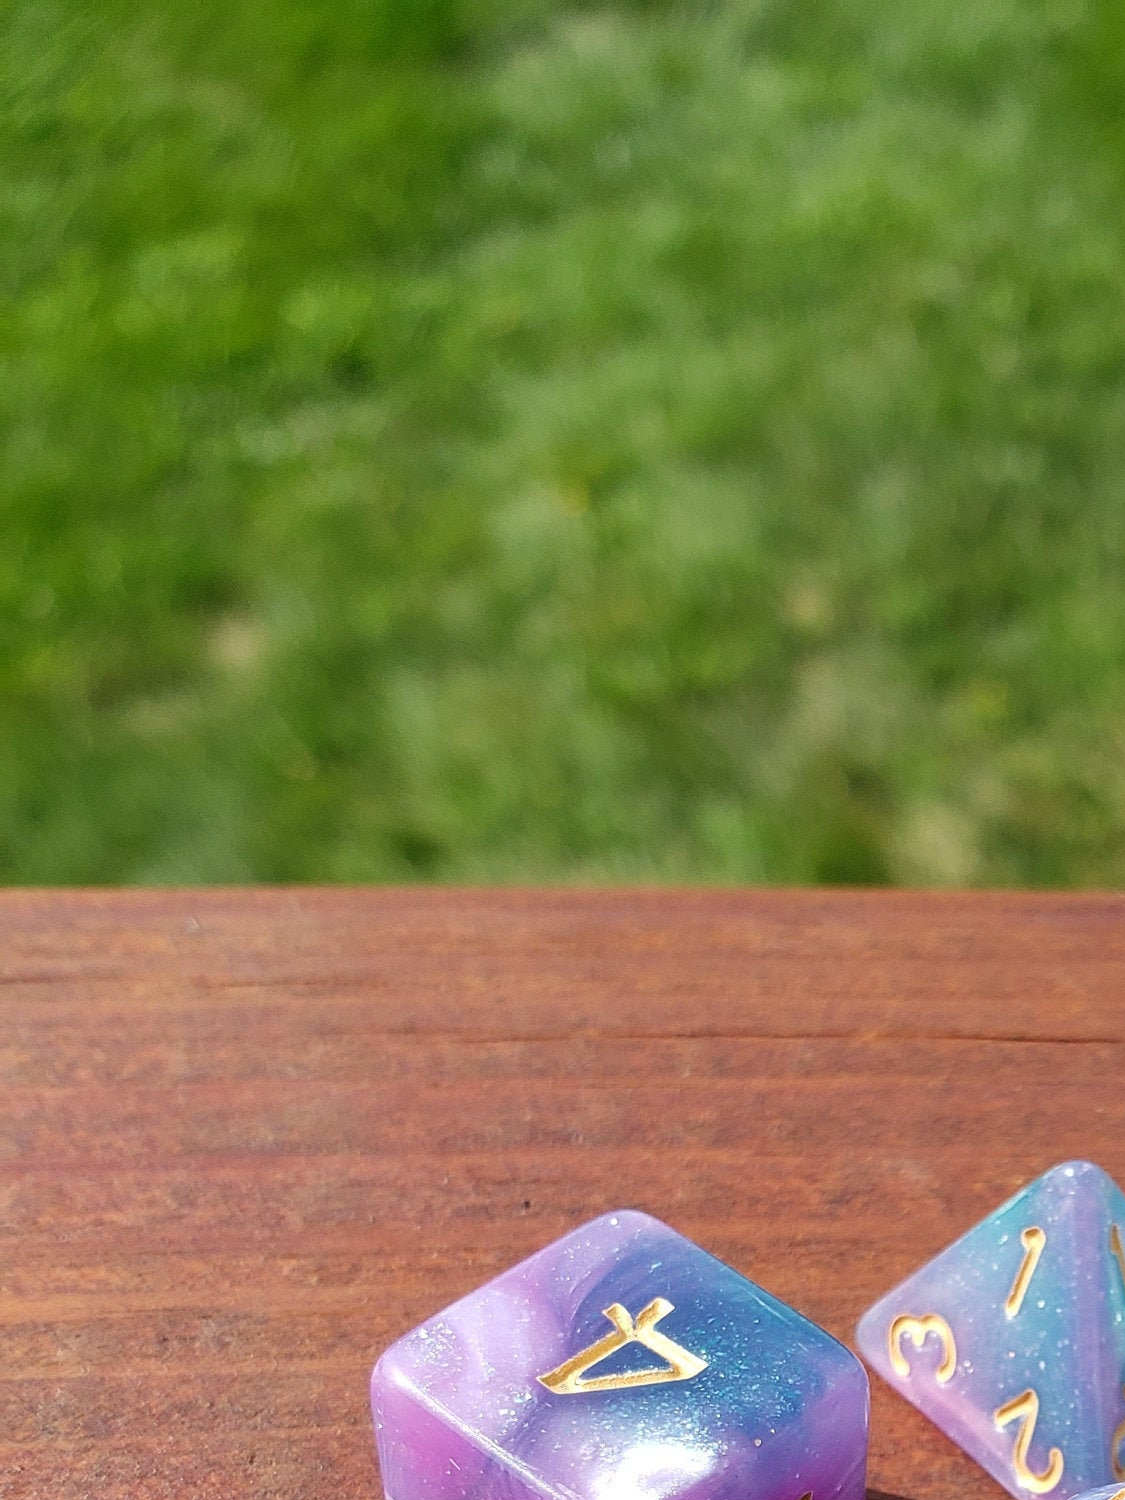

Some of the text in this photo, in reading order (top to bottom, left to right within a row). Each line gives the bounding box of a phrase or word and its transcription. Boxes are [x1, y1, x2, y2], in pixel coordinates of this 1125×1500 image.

[1005, 1226, 1046, 1319] 1
[535, 1297, 708, 1394] 4
[889, 1313, 957, 1383] 3
[995, 1387, 1064, 1494] 2
